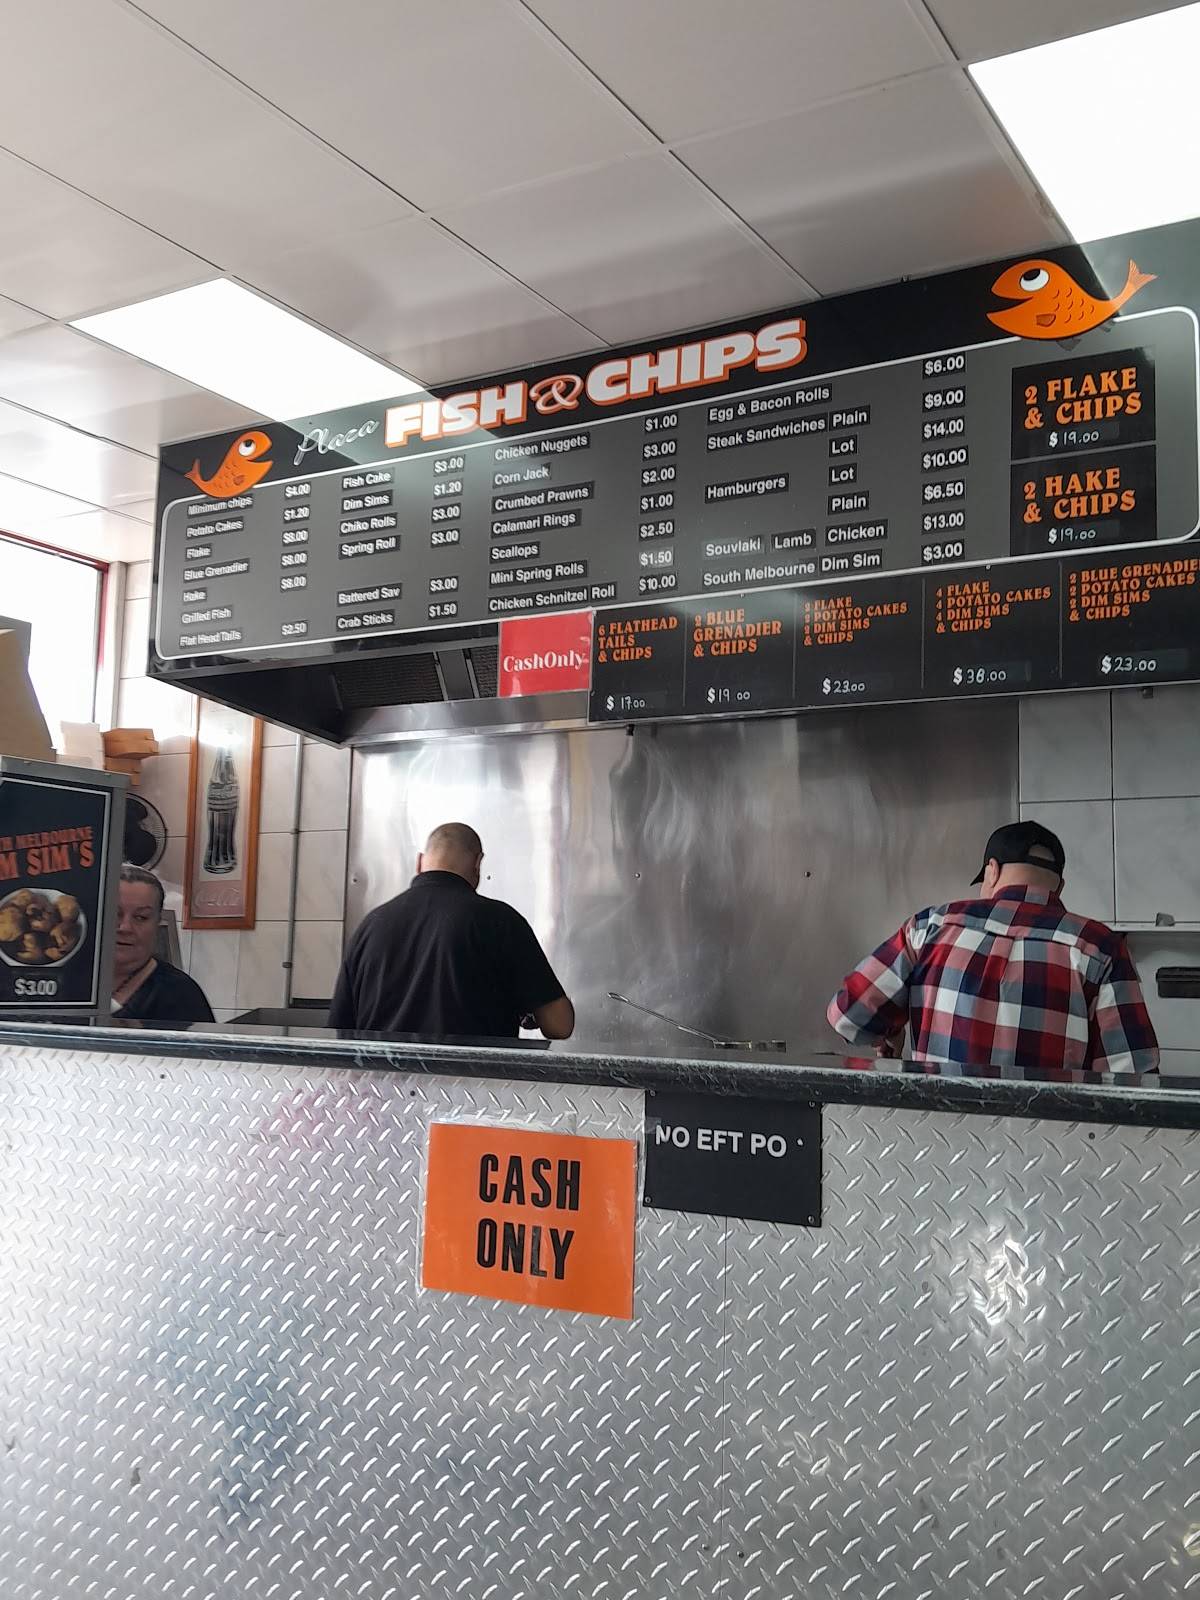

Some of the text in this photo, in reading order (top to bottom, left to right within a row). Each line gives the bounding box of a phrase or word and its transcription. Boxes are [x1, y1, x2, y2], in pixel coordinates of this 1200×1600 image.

[924, 355, 964, 376] $6.00
[383, 381, 528, 449] FISH
[529, 374, 584, 414] &
[586, 317, 808, 407] CHIPS
[1025, 367, 1137, 405] 2 FLAKE
[709, 387, 829, 422] Egg & Bacon Rolls
[924, 390, 964, 409] $9.00
[1024, 392, 1141, 429] & CHIPS
[645, 414, 677, 431] $1.00
[708, 410, 867, 450] Steak Sandwiches Plain
[924, 419, 964, 439] $14.00
[495, 435, 588, 460] Chicken Nuggets
[643, 441, 676, 458] $3.00
[831, 439, 854, 454] Lot
[434, 457, 464, 473] $3.00
[923, 449, 967, 469] $10.00
[343, 472, 391, 489] Fish Cake
[495, 467, 550, 485] Corn Jack
[642, 467, 675, 484] $2.00
[831, 467, 854, 482] Lot
[1024, 467, 1120, 500] 2 HAKE
[433, 481, 462, 496] $1.20
[707, 476, 786, 499] Hamburgers
[924, 482, 963, 501] $6.50
[188, 497, 253, 515] Minimum chips
[343, 494, 390, 511] Dim Sims
[495, 487, 589, 510] Crumbed Prawns
[641, 494, 673, 511] $1.00
[831, 496, 866, 511] Plain
[1024, 490, 1135, 523] & CHIPS
[284, 506, 309, 521] $1.20
[432, 506, 460, 521] $3.00
[923, 512, 964, 531] $13.00
[186, 520, 243, 538] Potato Cakes
[340, 516, 396, 534] Chiko Rolls
[493, 512, 576, 534] Calamari Rings
[640, 521, 673, 538] $2.50
[341, 537, 396, 556] Spring Roll
[431, 530, 459, 545] $3.00
[705, 523, 884, 556] Souvlaki Lamb Chicken
[186, 547, 211, 559] Flake
[491, 544, 538, 560] Scallops
[640, 550, 672, 566] $1.50
[923, 542, 963, 562] $3.00
[184, 562, 248, 580] Blue Grenadier
[490, 562, 584, 585] Mini Spring Rolls
[703, 552, 880, 586] South Melbourne Dim Sim
[1070, 558, 1200, 584] 2 BLUE GRENADIE
[430, 578, 457, 592] $3.00
[639, 575, 676, 591] $10.00
[947, 581, 990, 597] FLAKE
[1070, 572, 1195, 597] 2 POTATO CAKES
[183, 591, 206, 602] Hake
[338, 587, 400, 604] Battered Sav
[489, 585, 615, 611] Chicken Schnitzel Roll
[813, 596, 852, 611] FLAKE
[947, 592, 1001, 609] POTATO
[1006, 587, 1051, 602] CAKES
[1070, 590, 1150, 609] 2 DIM SIMS
[182, 608, 231, 623] Grilled Fish
[429, 603, 457, 617] $1.50
[706, 609, 745, 625] BLUE
[813, 607, 862, 622] POTATO
[867, 602, 907, 617] CAKES
[947, 607, 971, 621] DIM
[976, 603, 1010, 618] SIMS
[1070, 604, 1130, 621] & CHIPS
[337, 613, 393, 629] Crab Sticks
[599, 616, 678, 636] 6 FLATHEAD
[813, 622, 836, 634] DIM
[840, 618, 870, 630] SIMS
[936, 618, 991, 634] & CHIPS
[180, 630, 241, 646] Flat Head Tails
[693, 620, 782, 642] GRENADIER
[804, 631, 854, 646] & CHIPS
[598, 633, 635, 649] TAILS
[693, 638, 757, 657] & CHIPS
[598, 646, 653, 662] & CHIPS
[655, 1125, 803, 1158] NO EFT PO
[479, 1153, 581, 1211] CASH
[476, 1218, 574, 1280] ONLY
